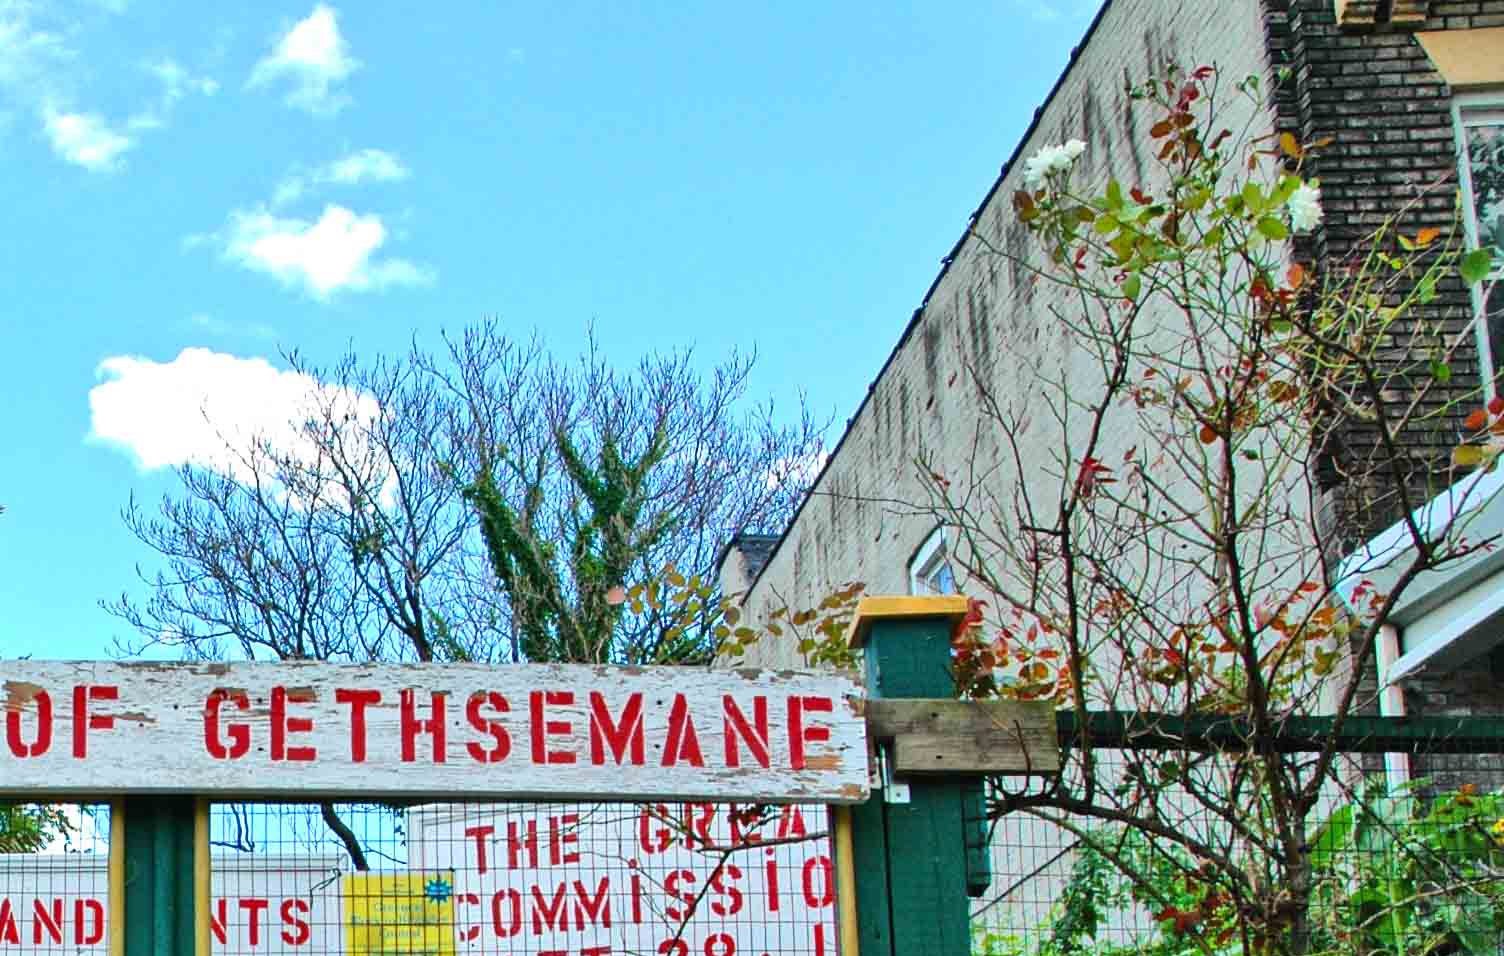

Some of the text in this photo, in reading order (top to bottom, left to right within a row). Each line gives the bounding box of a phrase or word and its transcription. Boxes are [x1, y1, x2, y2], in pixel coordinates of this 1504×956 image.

[4, 684, 119, 758] OF
[204, 684, 834, 770] GETHSEMANE
[465, 802, 807, 875] THE GREA
